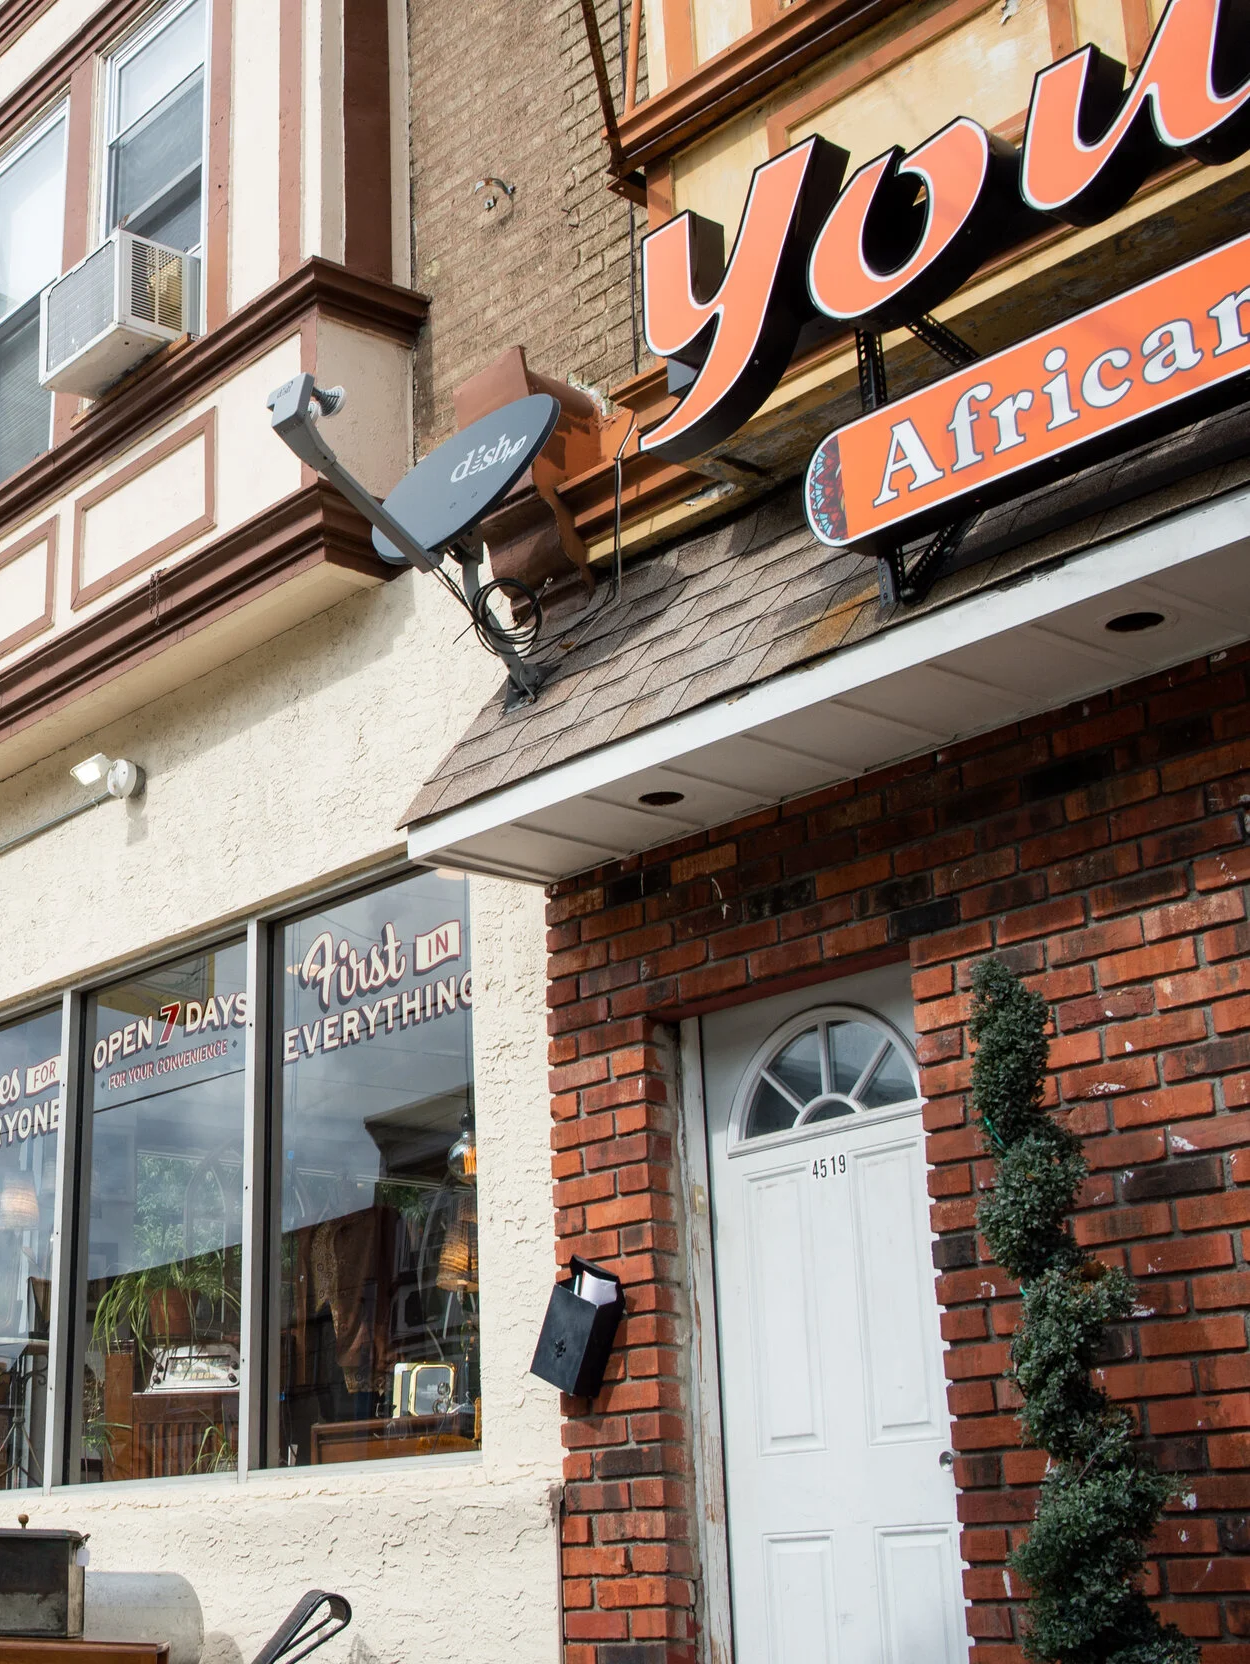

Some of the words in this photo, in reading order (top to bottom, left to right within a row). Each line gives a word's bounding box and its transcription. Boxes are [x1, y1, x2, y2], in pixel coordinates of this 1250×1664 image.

[301, 921, 407, 1008] First
[428, 930, 449, 963] IN
[92, 1015, 154, 1071] OPEN
[158, 1001, 182, 1047] 7
[184, 992, 247, 1034] DAYS
[282, 969, 472, 1062] EVERYTHING
[33, 1060, 57, 1089] FOR
[108, 1070, 127, 1091] FOR
[128, 1061, 155, 1084] YOUR
[156, 1039, 229, 1076] CONVENIENCE
[812, 1154, 847, 1180] 4519
